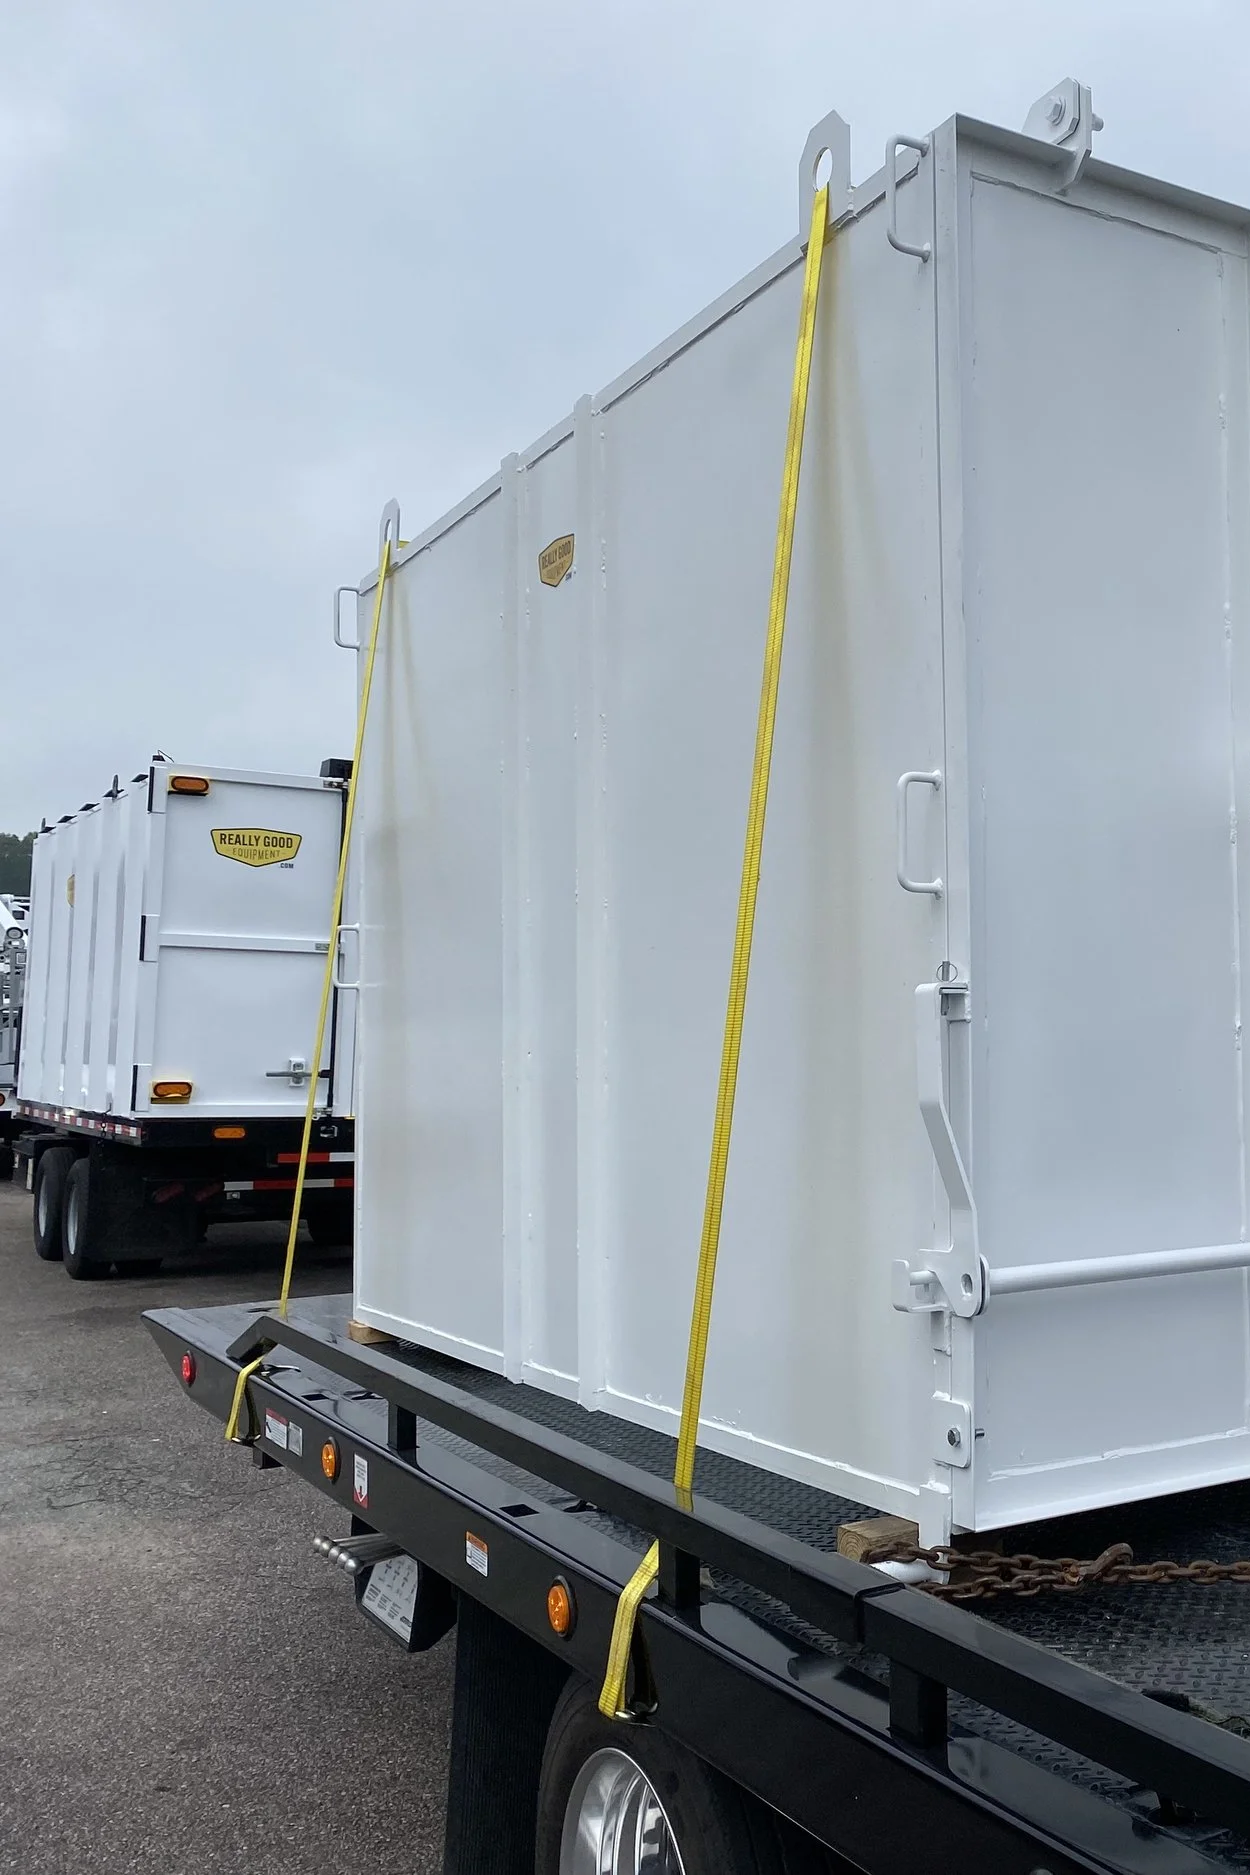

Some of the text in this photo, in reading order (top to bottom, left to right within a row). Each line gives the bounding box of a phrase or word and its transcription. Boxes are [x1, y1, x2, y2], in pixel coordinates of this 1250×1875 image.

[219, 833, 293, 849] REALLY GOOD
[232, 847, 281, 861] EQUIPMENT
